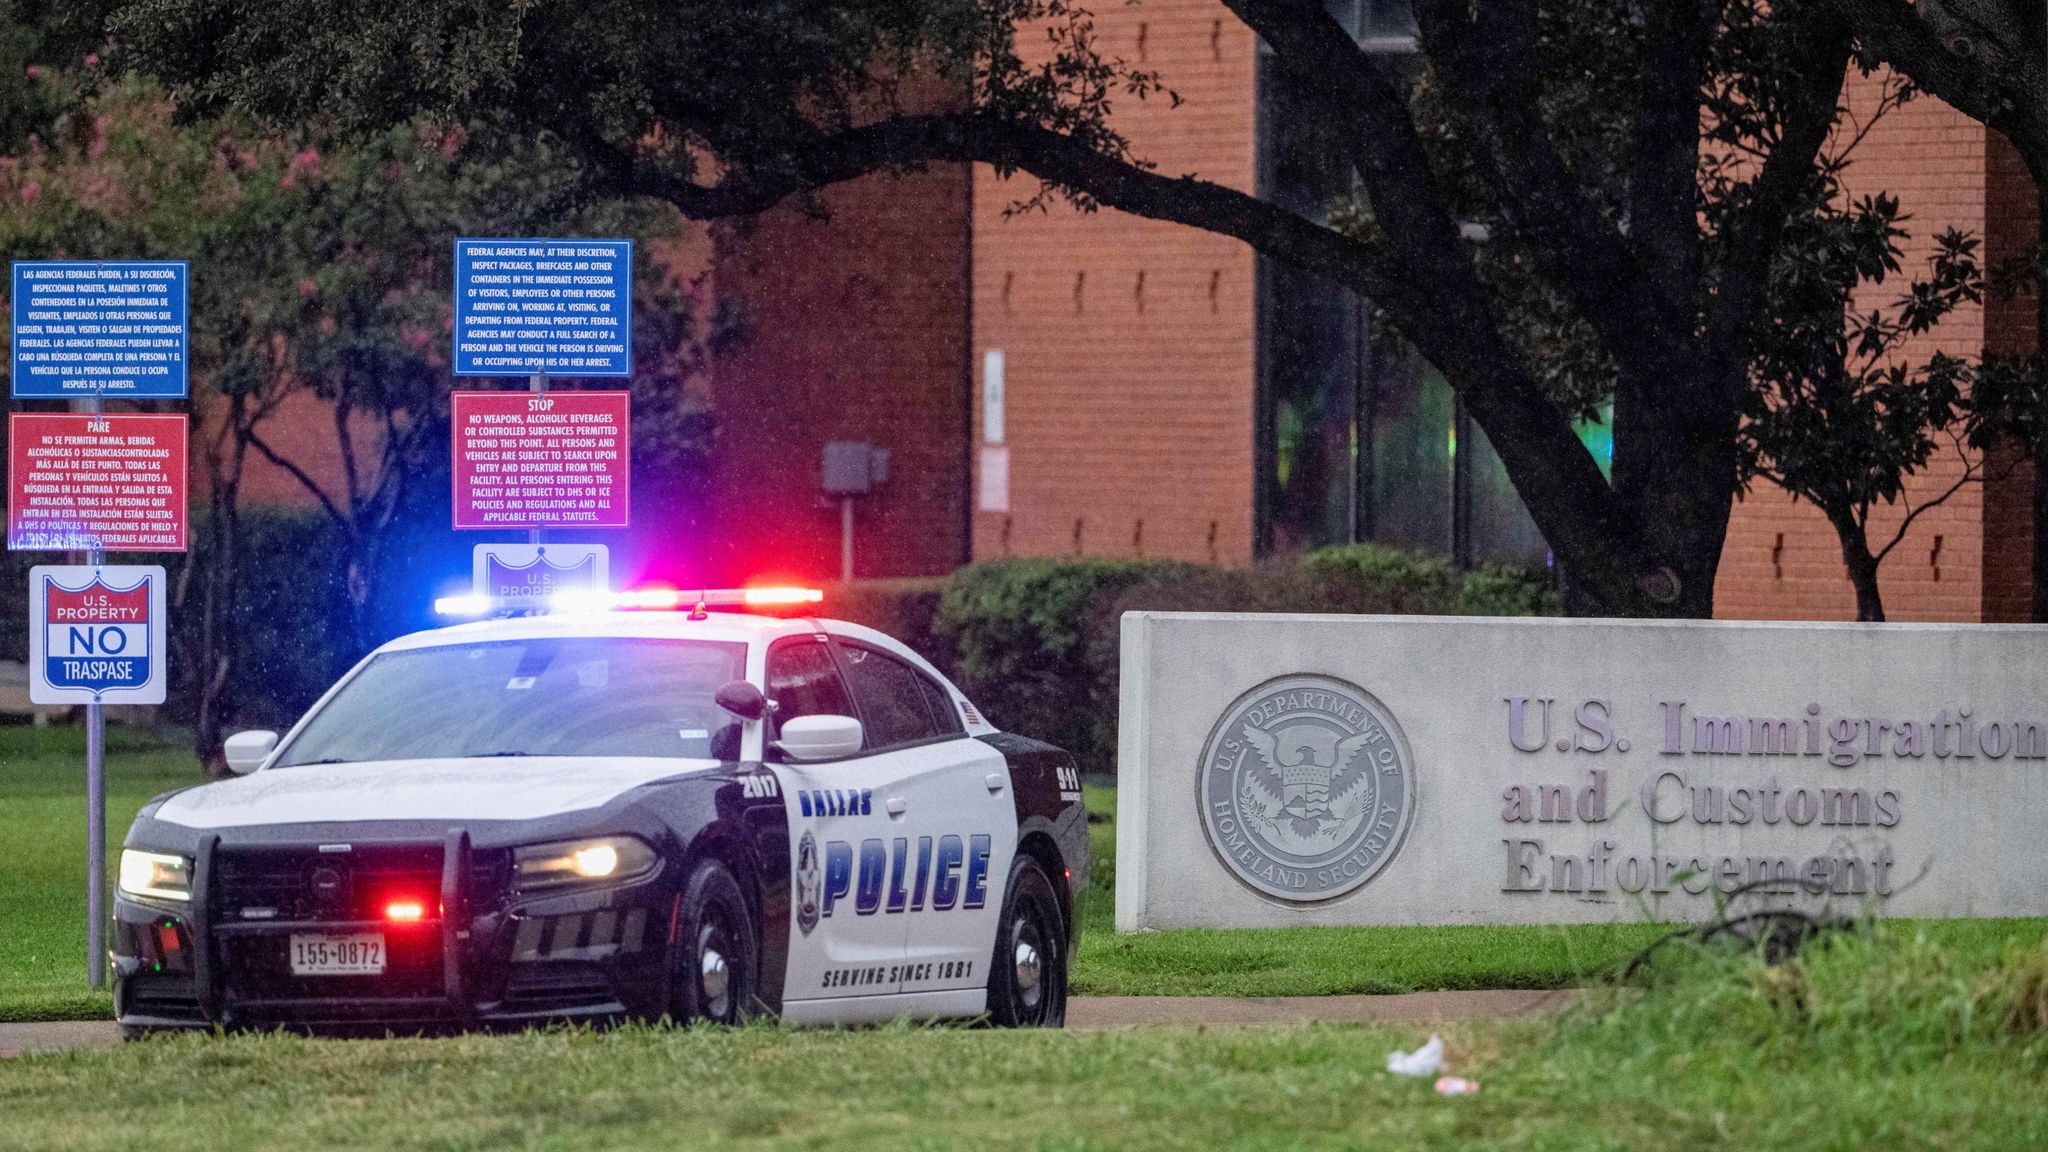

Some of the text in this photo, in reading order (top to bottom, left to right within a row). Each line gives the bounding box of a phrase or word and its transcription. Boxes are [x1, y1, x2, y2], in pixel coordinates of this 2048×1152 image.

[468, 248, 617, 258] FEDERAL AGENCIES MAY, AT THEIR DISCRETION,
[472, 262, 612, 271] INSPECT PACKAGES, BRIEFCASES AND OTHER
[24, 269, 176, 280] LAS AGENCIAS FEDERALES PUEDEN, A SU DISCRECIÓN,
[471, 276, 613, 284] CONTAINERS IN THE IMMEDIATE POSSESSION
[76, 285, 106, 294] PAQUETES,
[479, 290, 510, 299] VISITORS,
[32, 296, 168, 306] CONTENEDORES EN LA POSESIÓN INMEDIATA DE
[473, 303, 610, 312] ARRIVING ON, WORKING AT, VISITING, OR
[28, 312, 171, 321] VISITANTES, EMPLEADOS U OTRAS PERSONAS QUE
[466, 317, 617, 325] DEPARTING FROM FEDERAL PROPERTY. FEDERAL
[528, 400, 553, 411] STOP
[470, 415, 612, 424] NO WEAPONS, ALCOHOLIC BEVERAGES
[88, 422, 110, 432] PARE
[465, 427, 617, 435] OR CONTROLLED SUBSTANCES PERMITTED
[42, 436, 155, 446] NO SE PERMITEN ARMAS, BEBIDAS
[468, 439, 614, 448] BEYOND THIS POINT. ALL PERSONS AND
[28, 447, 72, 456] ALCOHÓLICAS
[466, 451, 617, 460] VEHICLES ARE SUBJECT TO SEARCH UPON
[37, 459, 160, 469] MÁS ALLÁ DE ESTE PUNTO. TODAS LAS
[476, 463, 606, 472] ENTRY AND DEPARTURE FROM THIS
[29, 471, 167, 481] PERSONAS Y VEHÍCULOS ESTÁN SUJETOS A
[470, 476, 612, 484] FACILITY. ALL PERSONS ENTERING THIS
[473, 488, 610, 496] FACILITY ARE SUBJECT TO DHS OR ICE
[472, 500, 610, 509] POLICIES AND REGULATIONS AND ALL
[484, 512, 598, 521] APPLICABLE FEDERAL STATUTES.
[528, 574, 556, 584] U.S.
[84, 596, 112, 606] U.S.
[57, 608, 138, 618] PROPERTY
[70, 626, 126, 655] NO
[63, 662, 132, 679] TRASPASE
[1215, 693, 1399, 777] U.S. DEPARTMENT OF
[1504, 697, 2048, 767] U.S. Immigration
[738, 775, 777, 798] 2017
[798, 789, 872, 817] DALLAS
[1501, 771, 1902, 827] and Customs
[1214, 800, 1397, 888] HOMELAND SECURITY
[1501, 838, 1895, 897] Enforcement
[822, 834, 991, 917] POLICE
[822, 961, 973, 988] SERVING SINCE 1881
